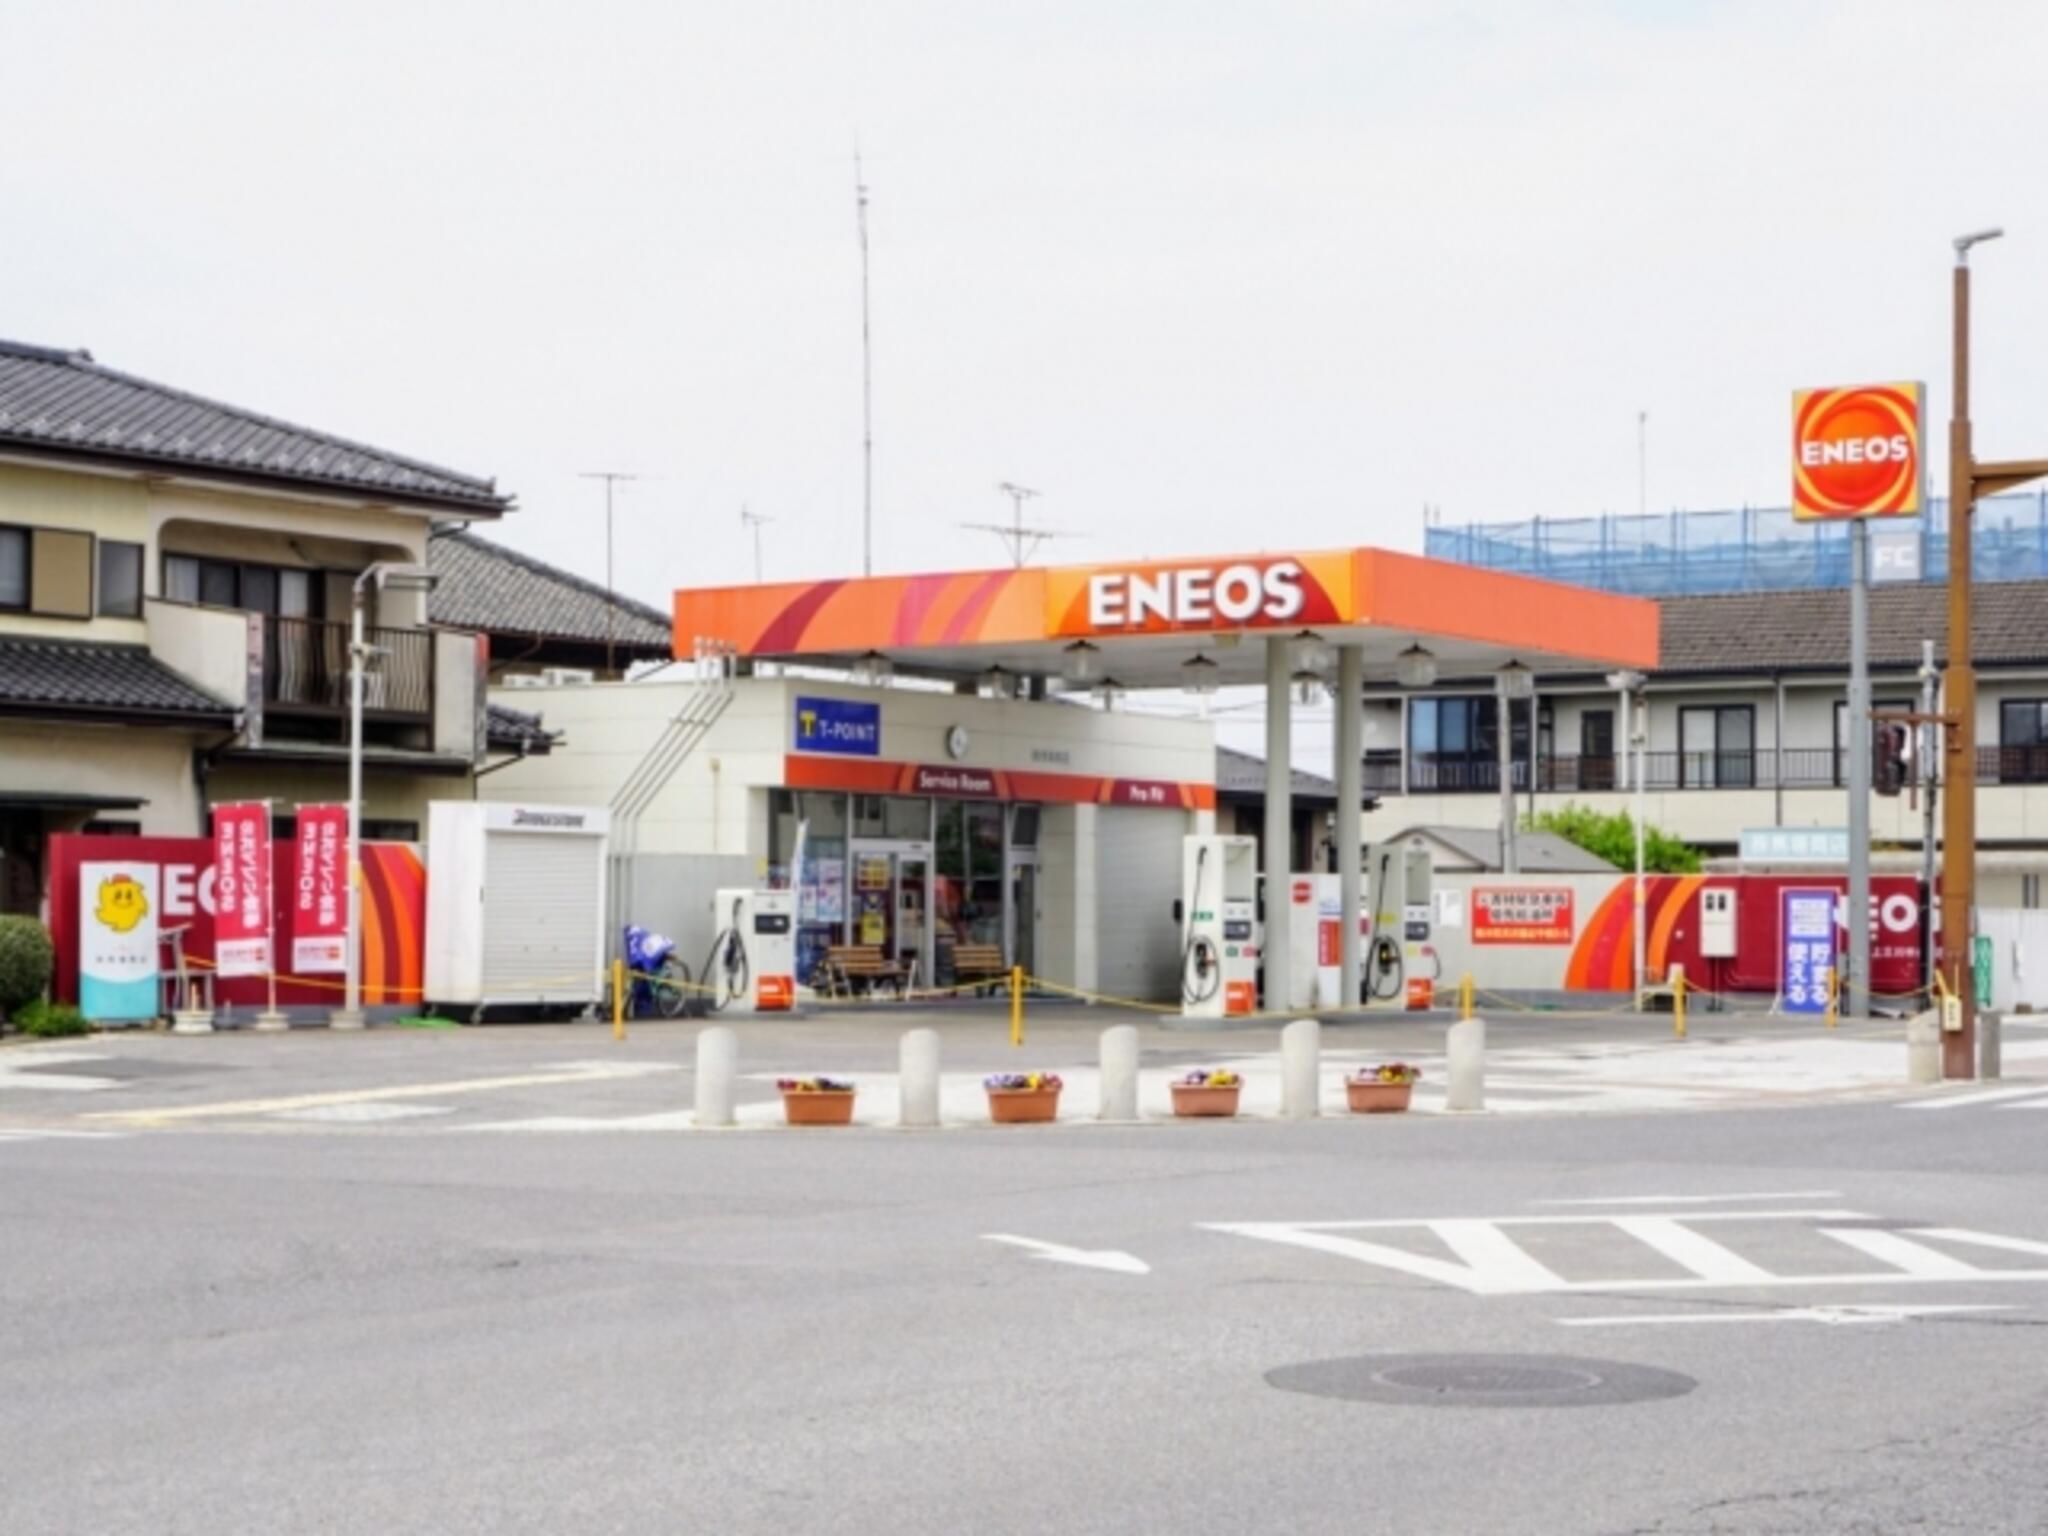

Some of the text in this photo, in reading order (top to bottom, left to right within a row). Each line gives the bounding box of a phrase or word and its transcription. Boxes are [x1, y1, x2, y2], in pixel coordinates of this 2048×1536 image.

[1801, 434, 1909, 467] ENEOS
[1874, 546, 1916, 568] FC
[1088, 561, 1304, 626] ENEOS
[819, 719, 875, 741] T-POINT
[919, 770, 990, 791] Service Room
